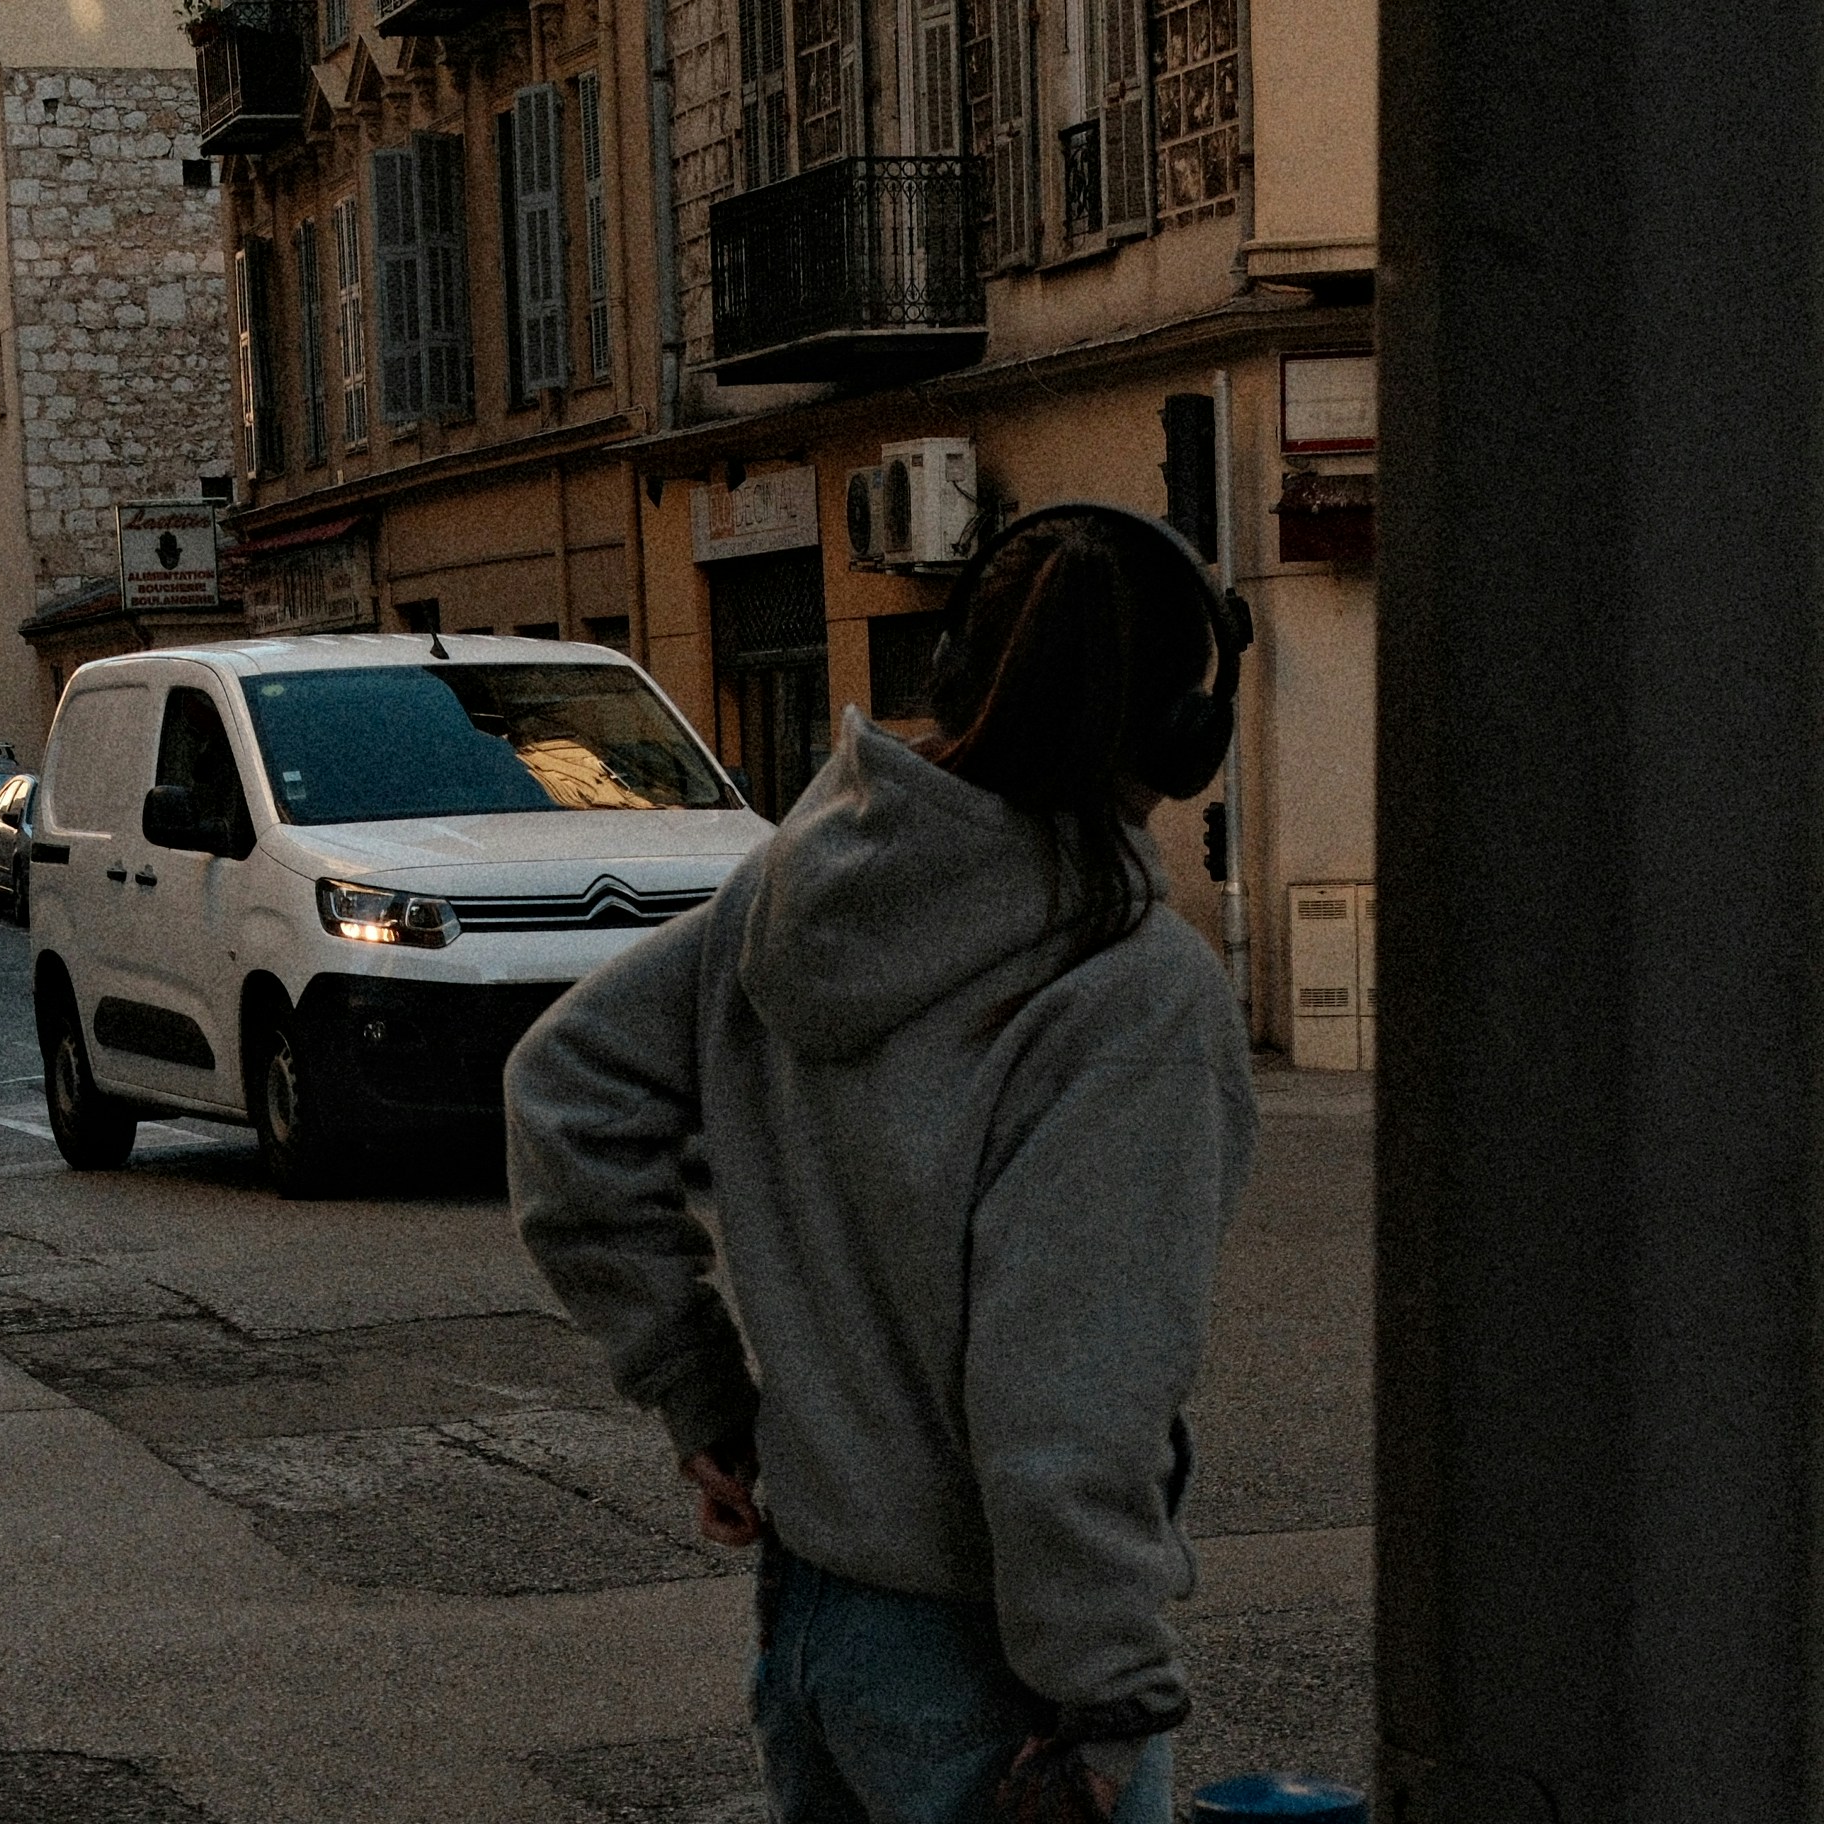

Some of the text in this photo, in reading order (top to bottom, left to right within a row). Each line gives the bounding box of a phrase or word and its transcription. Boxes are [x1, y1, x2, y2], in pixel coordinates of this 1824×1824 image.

[128, 571, 214, 581] ALIMENTATION
[138, 583, 207, 593] BOUCHERIE
[131, 595, 216, 606] BOULANGERIE
